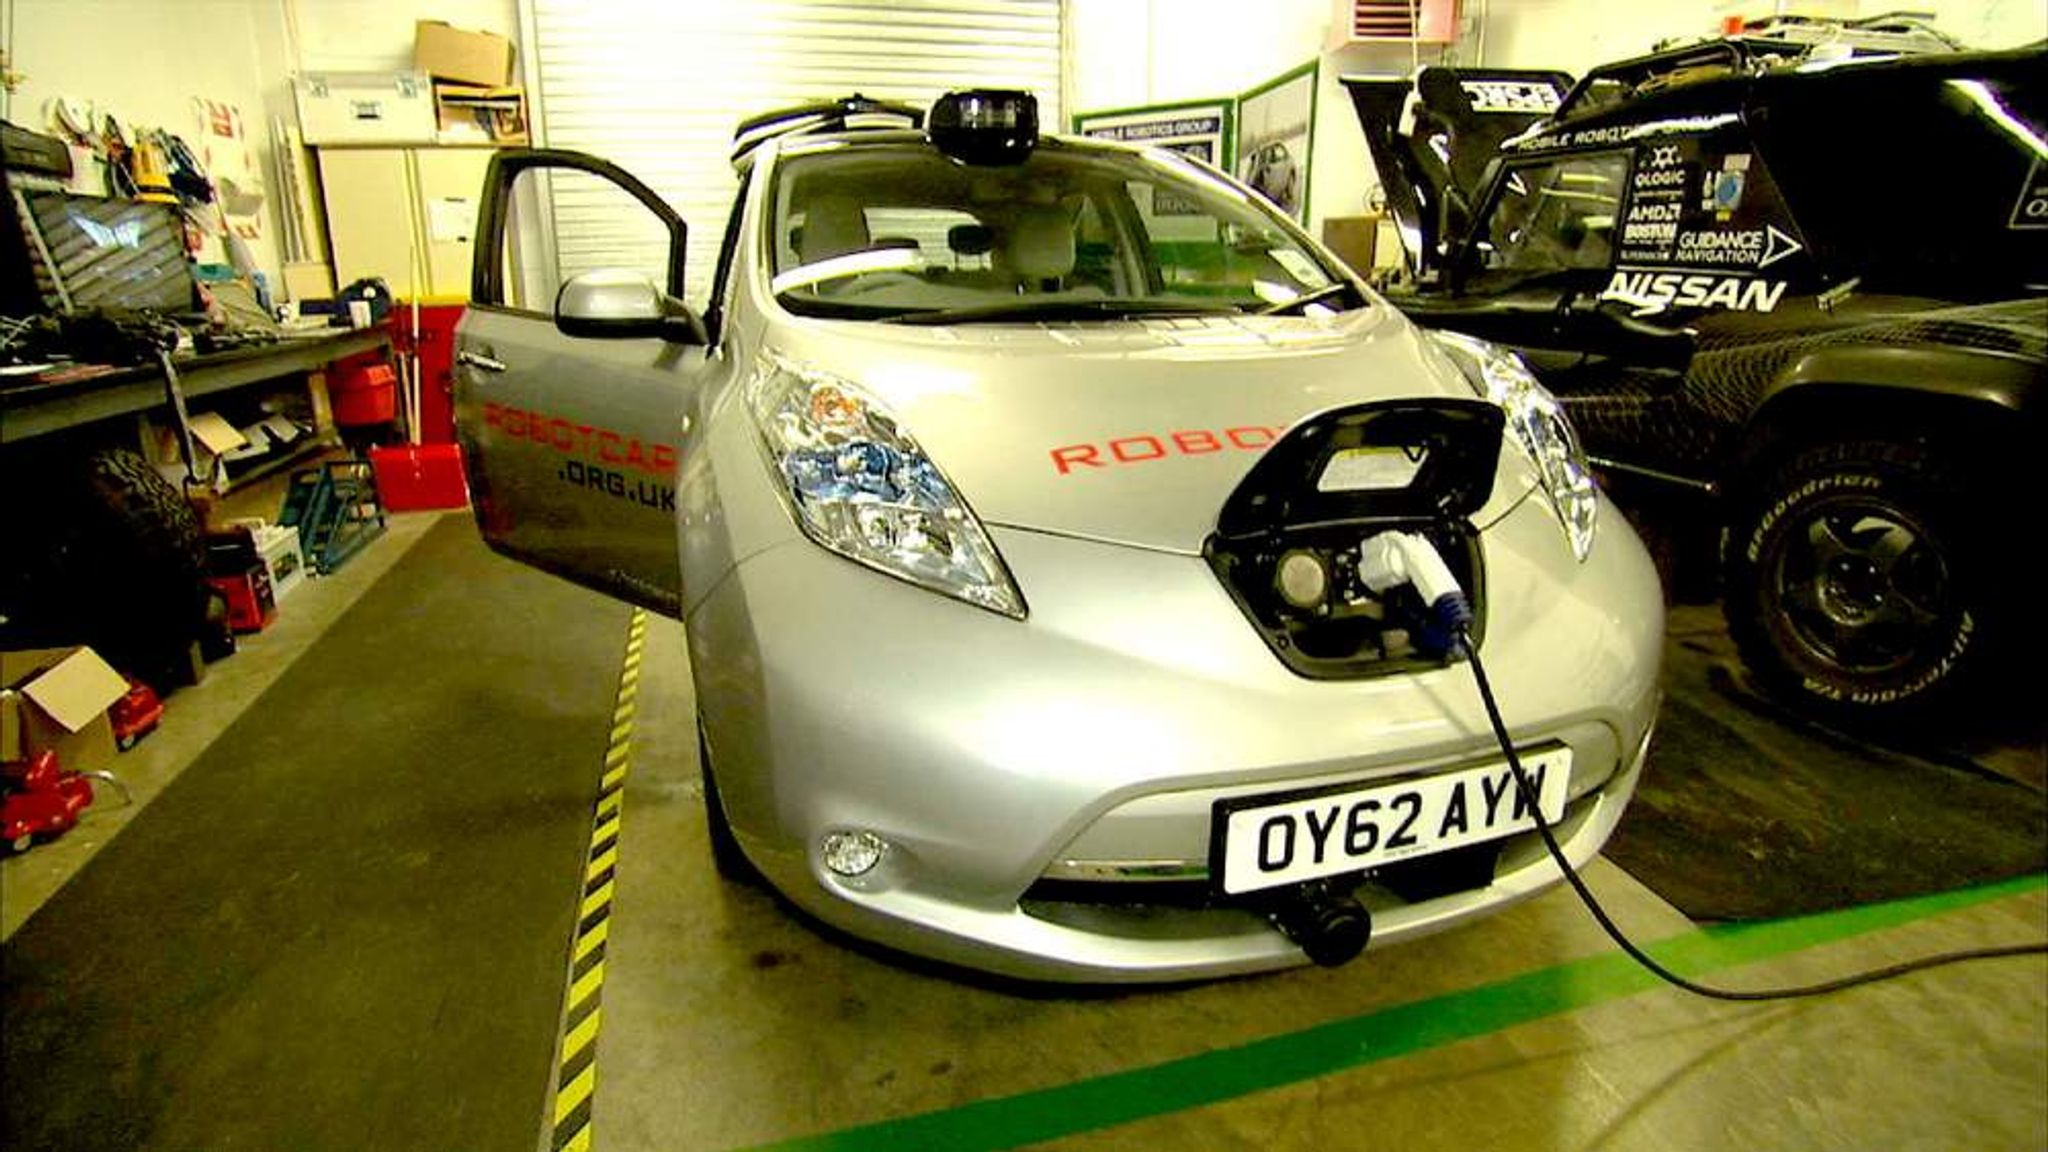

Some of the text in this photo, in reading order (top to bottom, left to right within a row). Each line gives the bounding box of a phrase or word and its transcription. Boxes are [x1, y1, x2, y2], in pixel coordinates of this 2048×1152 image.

[1127, 123, 1172, 138] ROBOTICS
[1175, 118, 1213, 134] GROUP
[1634, 170, 1686, 187] QLOGIC
[1628, 204, 1668, 221] AMD
[1624, 223, 1677, 239] BOSTON
[1680, 230, 1763, 250] GUIDANCE
[1674, 250, 1761, 264] NAVIGATION
[1601, 271, 1788, 313] NISSAN
[1049, 425, 1288, 475] ROBO
[558, 459, 676, 512] .ORG.UK
[1258, 763, 1547, 872] OY62 AYW
